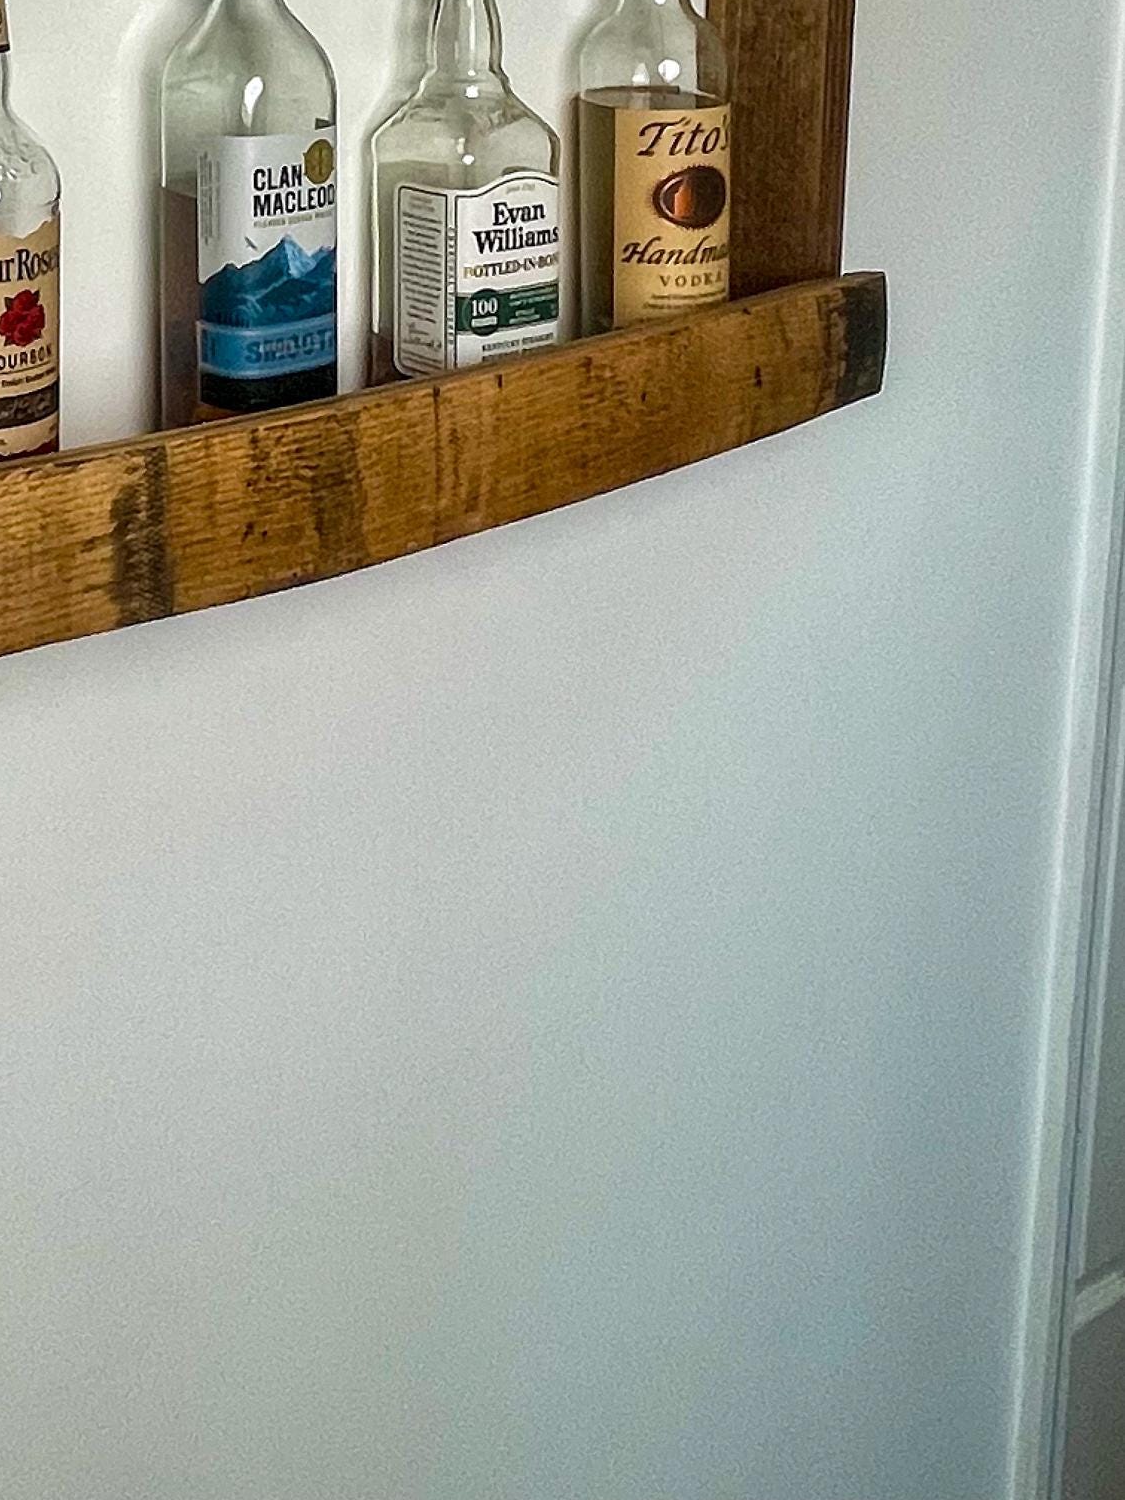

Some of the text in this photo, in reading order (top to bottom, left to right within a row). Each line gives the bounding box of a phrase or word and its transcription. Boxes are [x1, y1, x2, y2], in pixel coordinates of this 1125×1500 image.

[253, 164, 302, 191] CLAN
[253, 183, 335, 218] MACLEOD
[492, 202, 546, 225] Evan
[472, 227, 560, 254] Williams
[472, 297, 498, 317] 100
